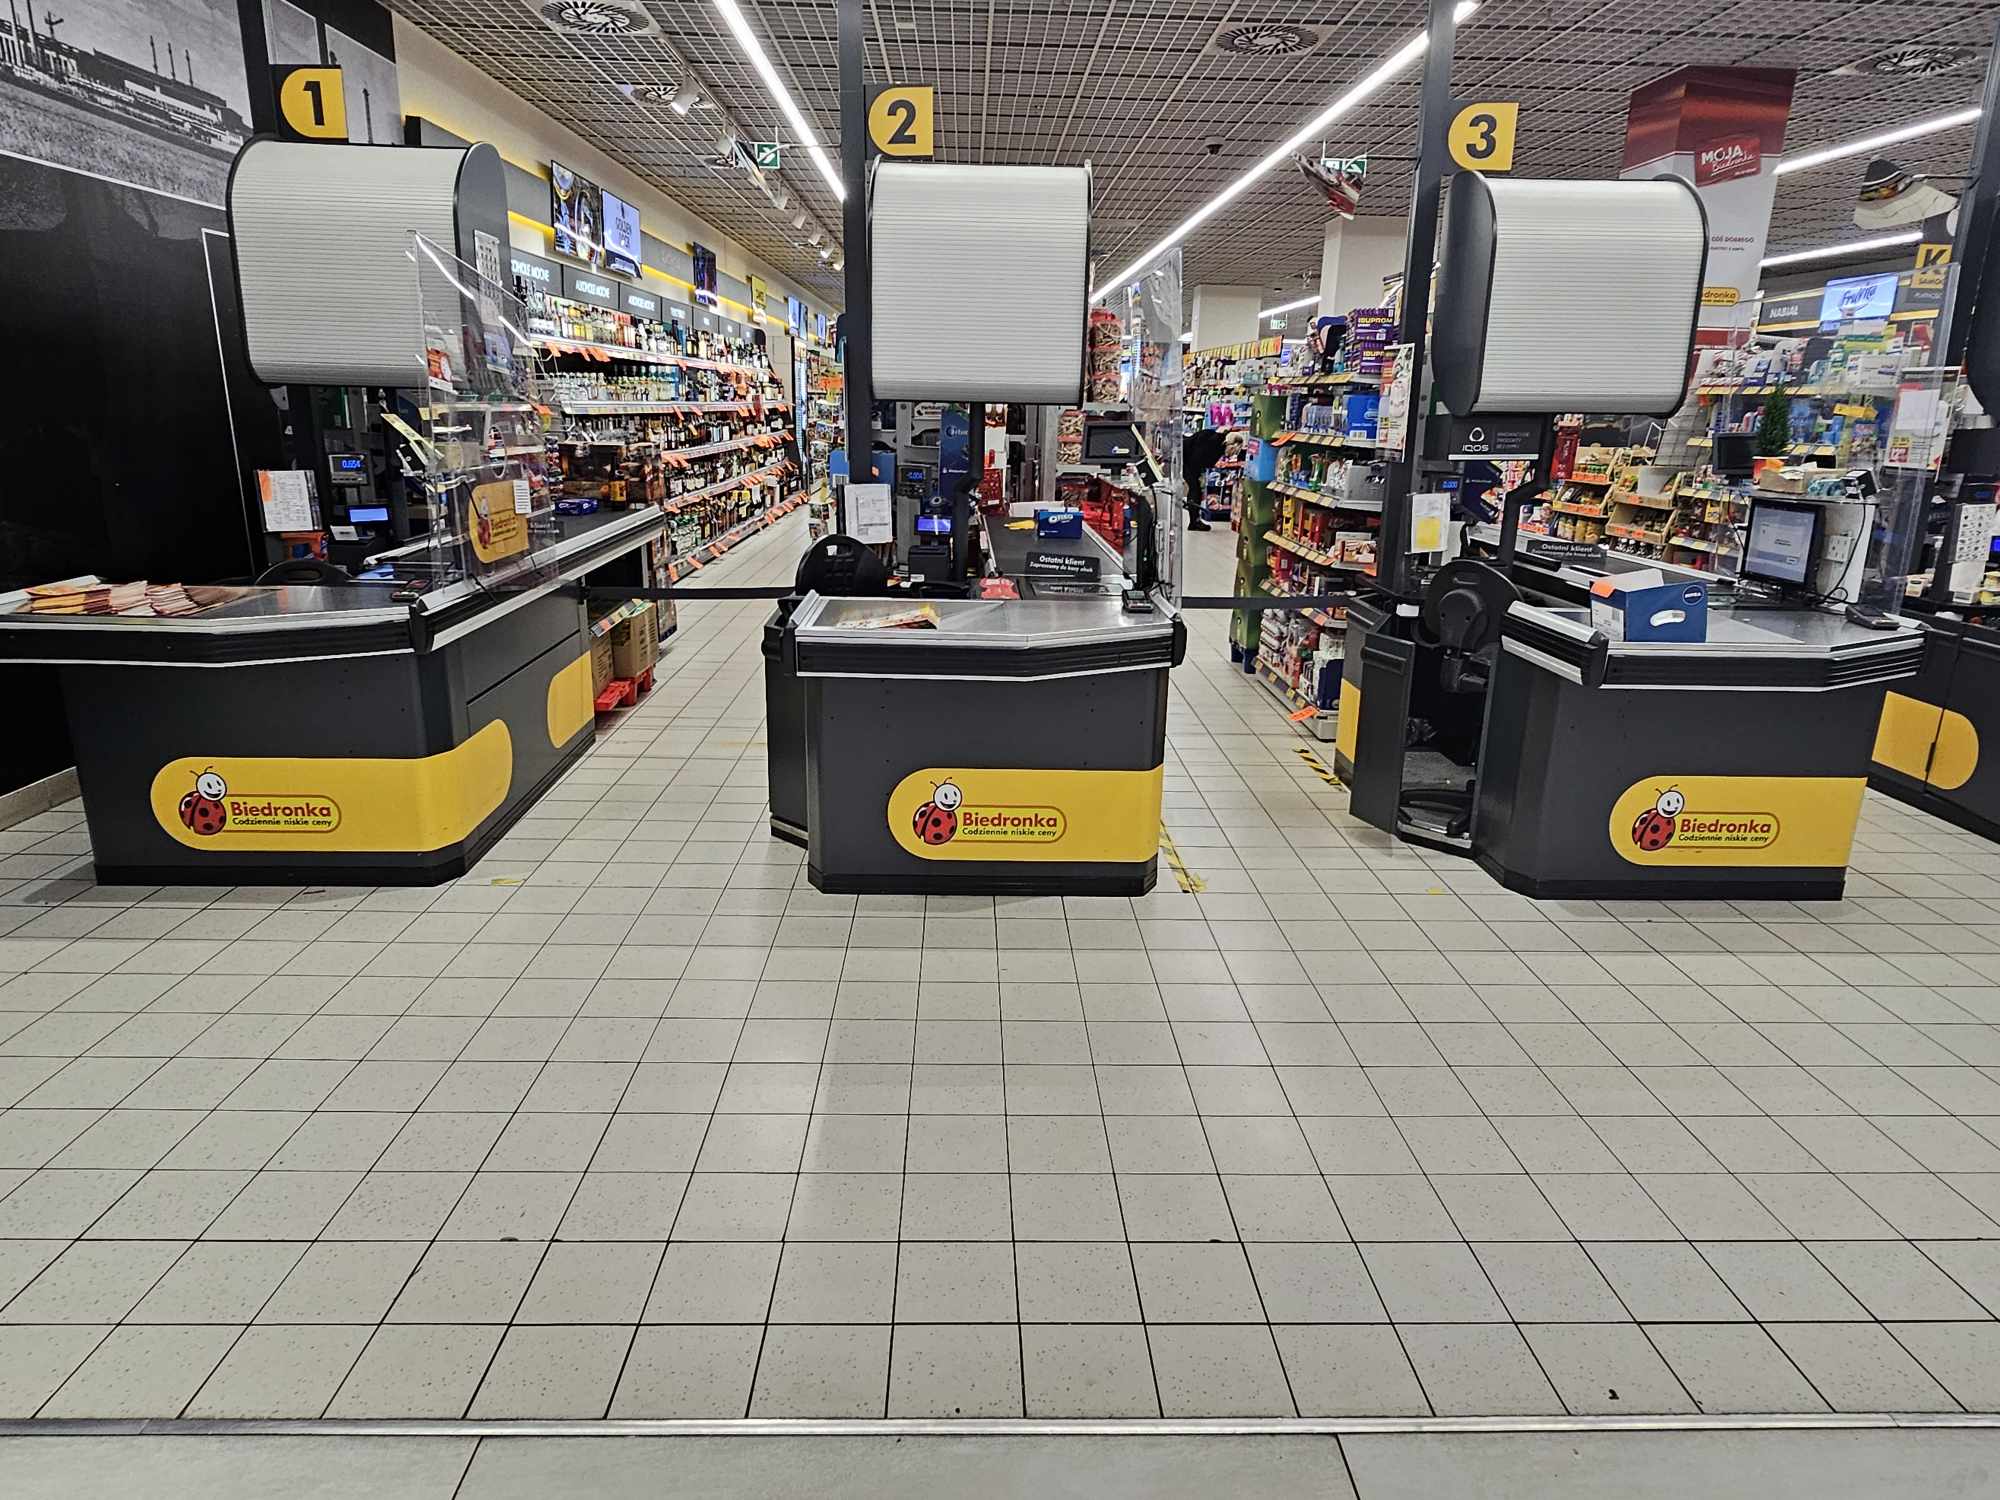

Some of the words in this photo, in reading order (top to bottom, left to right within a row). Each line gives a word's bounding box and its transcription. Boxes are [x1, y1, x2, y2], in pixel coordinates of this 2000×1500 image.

[303, 80, 326, 127] 1
[887, 99, 918, 145] 2
[1465, 113, 1498, 160] 3
[1700, 144, 1743, 166] MOJA
[1704, 290, 1736, 299] dronka
[1462, 443, 1489, 453] IQOS
[1541, 543, 1569, 551] Ostatni
[1570, 545, 1593, 553] klient
[1039, 555, 1064, 564] Ostatni
[1065, 556, 1086, 566] klient
[231, 802, 331, 817] Biedronka
[232, 818, 280, 826] Codziennie
[284, 818, 309, 826] niskie
[962, 812, 1057, 827] Biedronka
[1680, 818, 1771, 833] Biedronka
[1010, 828, 1035, 836] niskie
[1724, 834, 1748, 842] niskie
[1750, 835, 1769, 843] ceny
